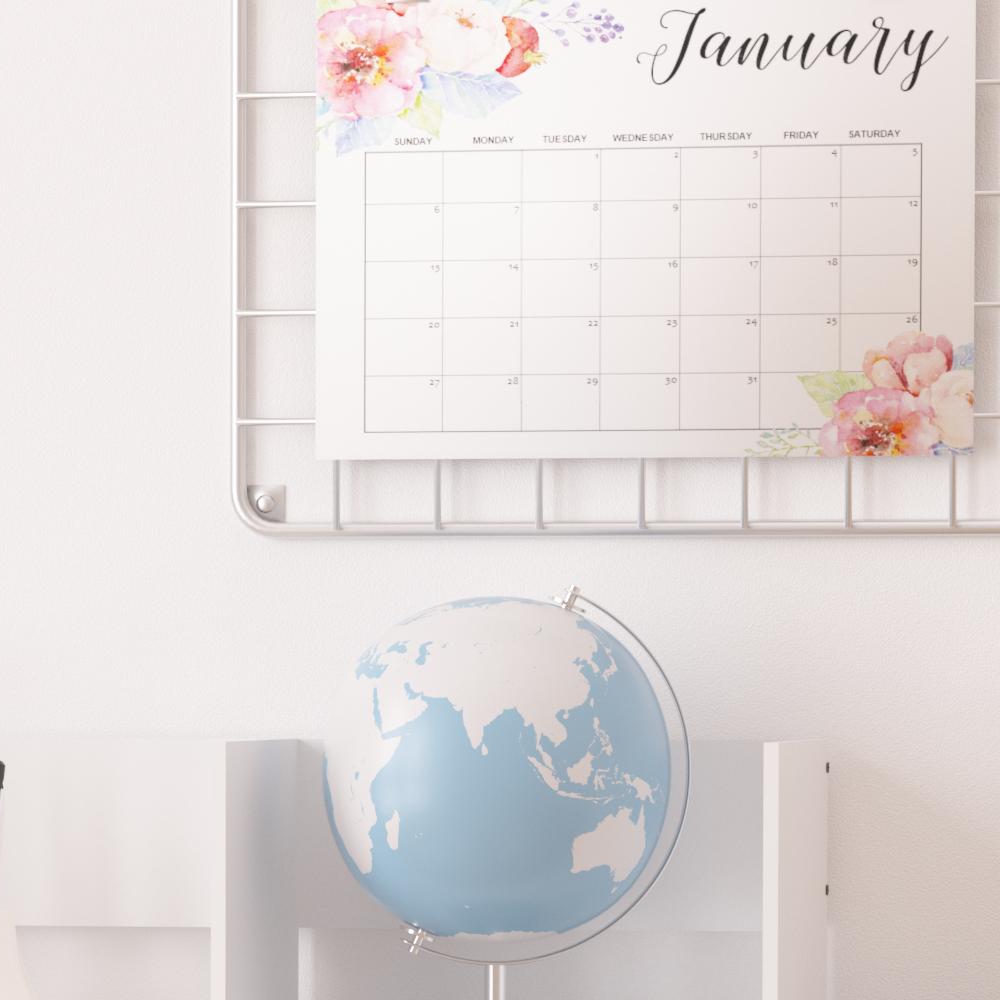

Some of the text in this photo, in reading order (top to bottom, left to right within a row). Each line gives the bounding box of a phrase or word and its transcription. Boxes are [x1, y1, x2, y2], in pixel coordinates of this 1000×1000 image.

[636, 7, 949, 92] January
[394, 129, 901, 146] SUNDAY MONDAY TUESDAY WEDNESDAY THURSDAY FRIDAY SATURDAY
[748, 202, 758, 210] 10
[431, 264, 441, 273] 13
[589, 263, 599, 271] 15
[668, 260, 679, 269] 16
[749, 261, 759, 269] 17
[828, 257, 839, 267] 18
[908, 258, 919, 267] 19
[667, 319, 678, 327] 23
[745, 318, 757, 327] 24
[826, 317, 838, 326] 25
[906, 315, 918, 324] 26
[429, 376, 757, 388] 27 28 29 30 31
